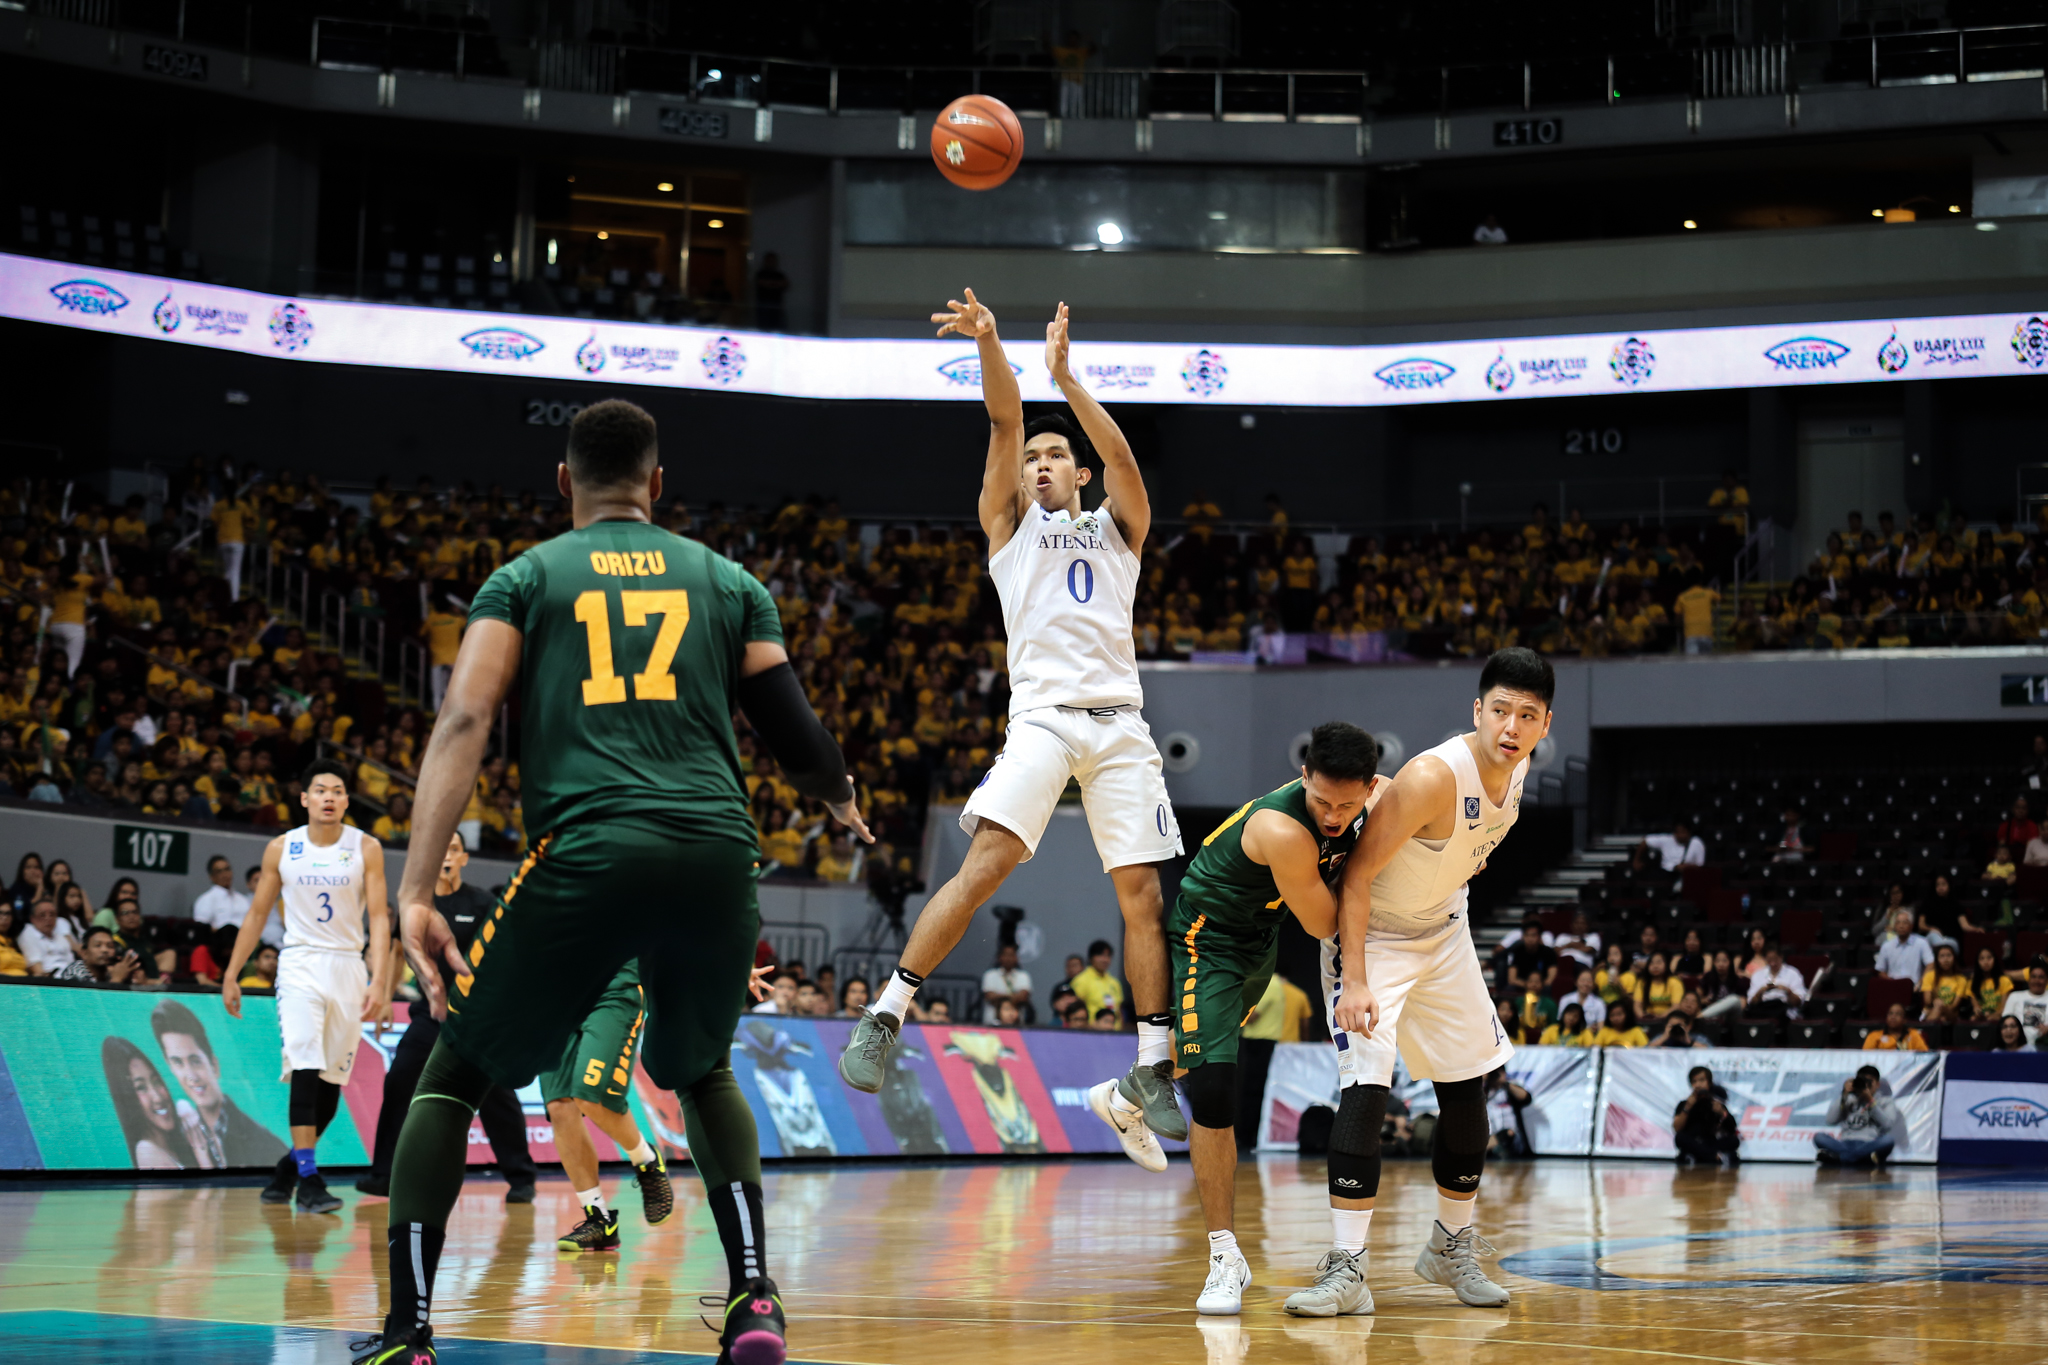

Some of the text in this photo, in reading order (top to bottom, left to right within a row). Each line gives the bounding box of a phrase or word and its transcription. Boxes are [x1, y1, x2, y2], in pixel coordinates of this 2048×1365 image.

[1500, 121, 1557, 145] 410
[1774, 351, 1837, 371] ARENA
[1565, 429, 1622, 455] 210
[590, 550, 667, 577] ORIZU
[1067, 558, 1094, 604] 0
[574, 589, 690, 707] 17
[1156, 803, 1168, 837] 0
[128, 831, 173, 868] 107
[296, 875, 351, 887] ATENEO
[316, 892, 334, 923] 3
[1490, 1013, 1504, 1048] 1
[339, 1051, 353, 1073] 3
[1183, 1043, 1201, 1056] FEU
[583, 1058, 606, 1087] 5
[1978, 1110, 2040, 1128] ARENA
